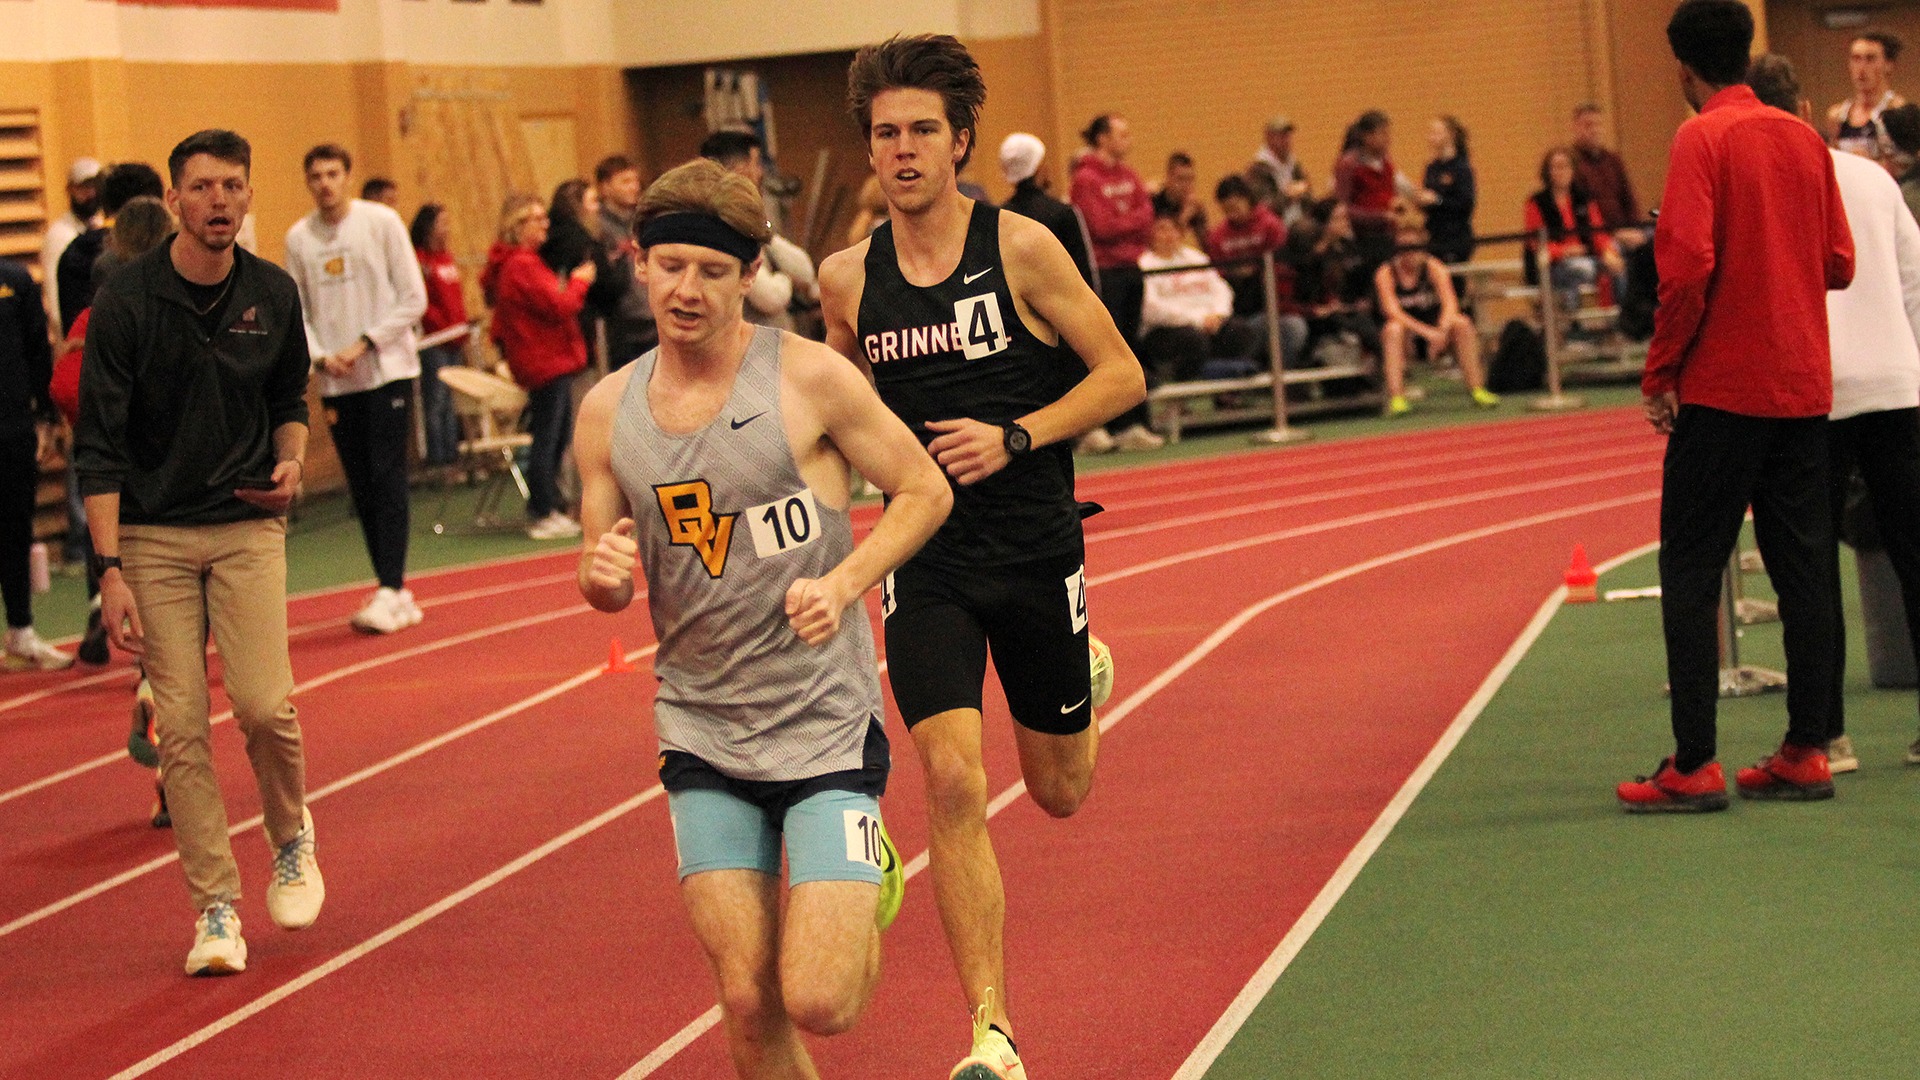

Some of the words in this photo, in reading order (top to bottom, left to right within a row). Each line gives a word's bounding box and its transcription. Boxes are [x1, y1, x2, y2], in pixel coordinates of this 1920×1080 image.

[864, 322, 1012, 364] GRINNE
[968, 300, 999, 352] 4
[651, 478, 741, 579] BV
[762, 497, 810, 550] 10
[857, 815, 881, 867] 10
